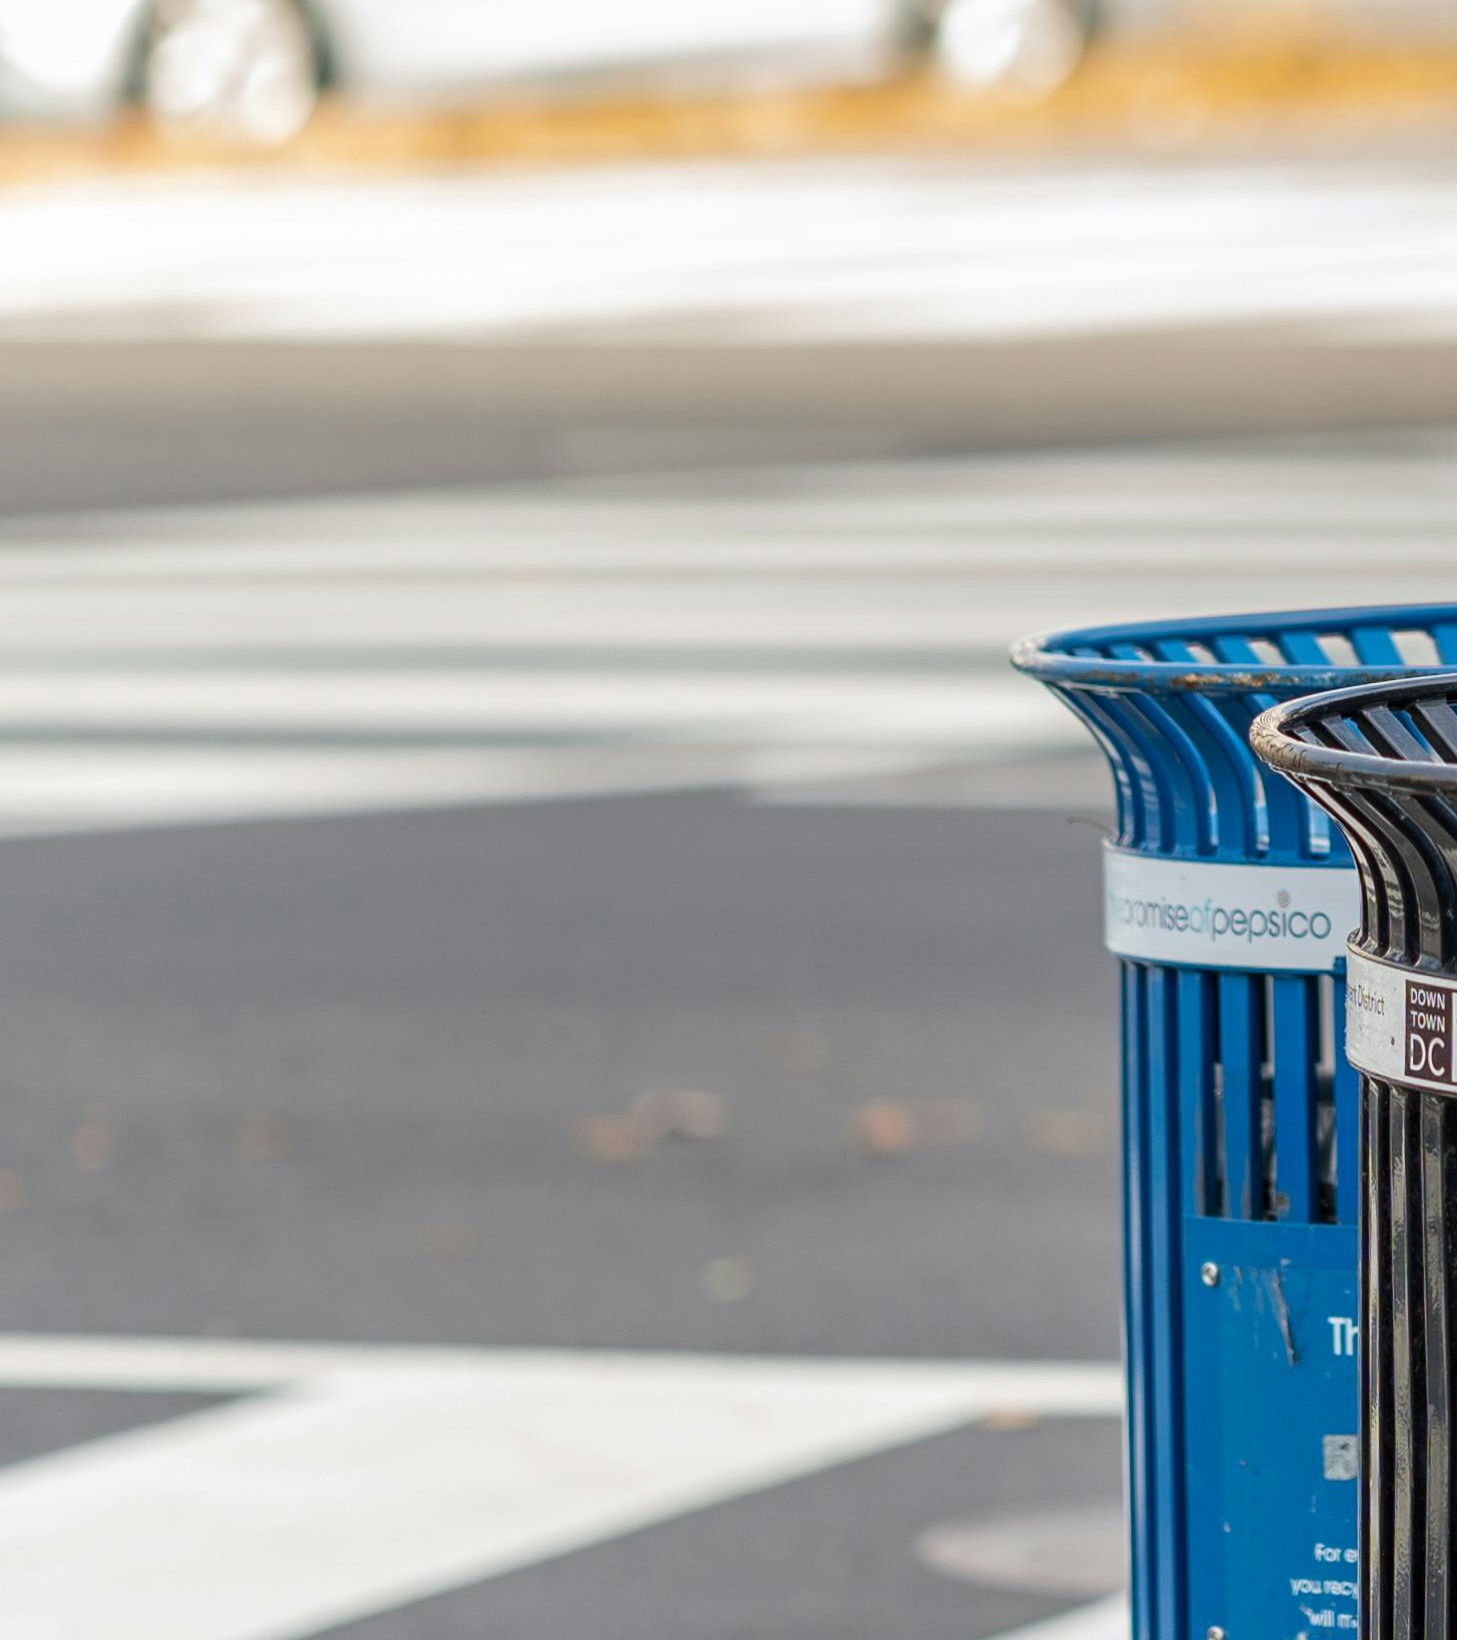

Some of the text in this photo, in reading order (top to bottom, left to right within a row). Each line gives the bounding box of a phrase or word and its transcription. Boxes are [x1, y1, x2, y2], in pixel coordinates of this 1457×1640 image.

[1410, 987, 1446, 1011] DOWN
[1410, 1010, 1446, 1034] TOWN
[1409, 1033, 1446, 1077] DC
[1314, 1543, 1342, 1563] For
[1290, 1578, 1323, 1597] you
